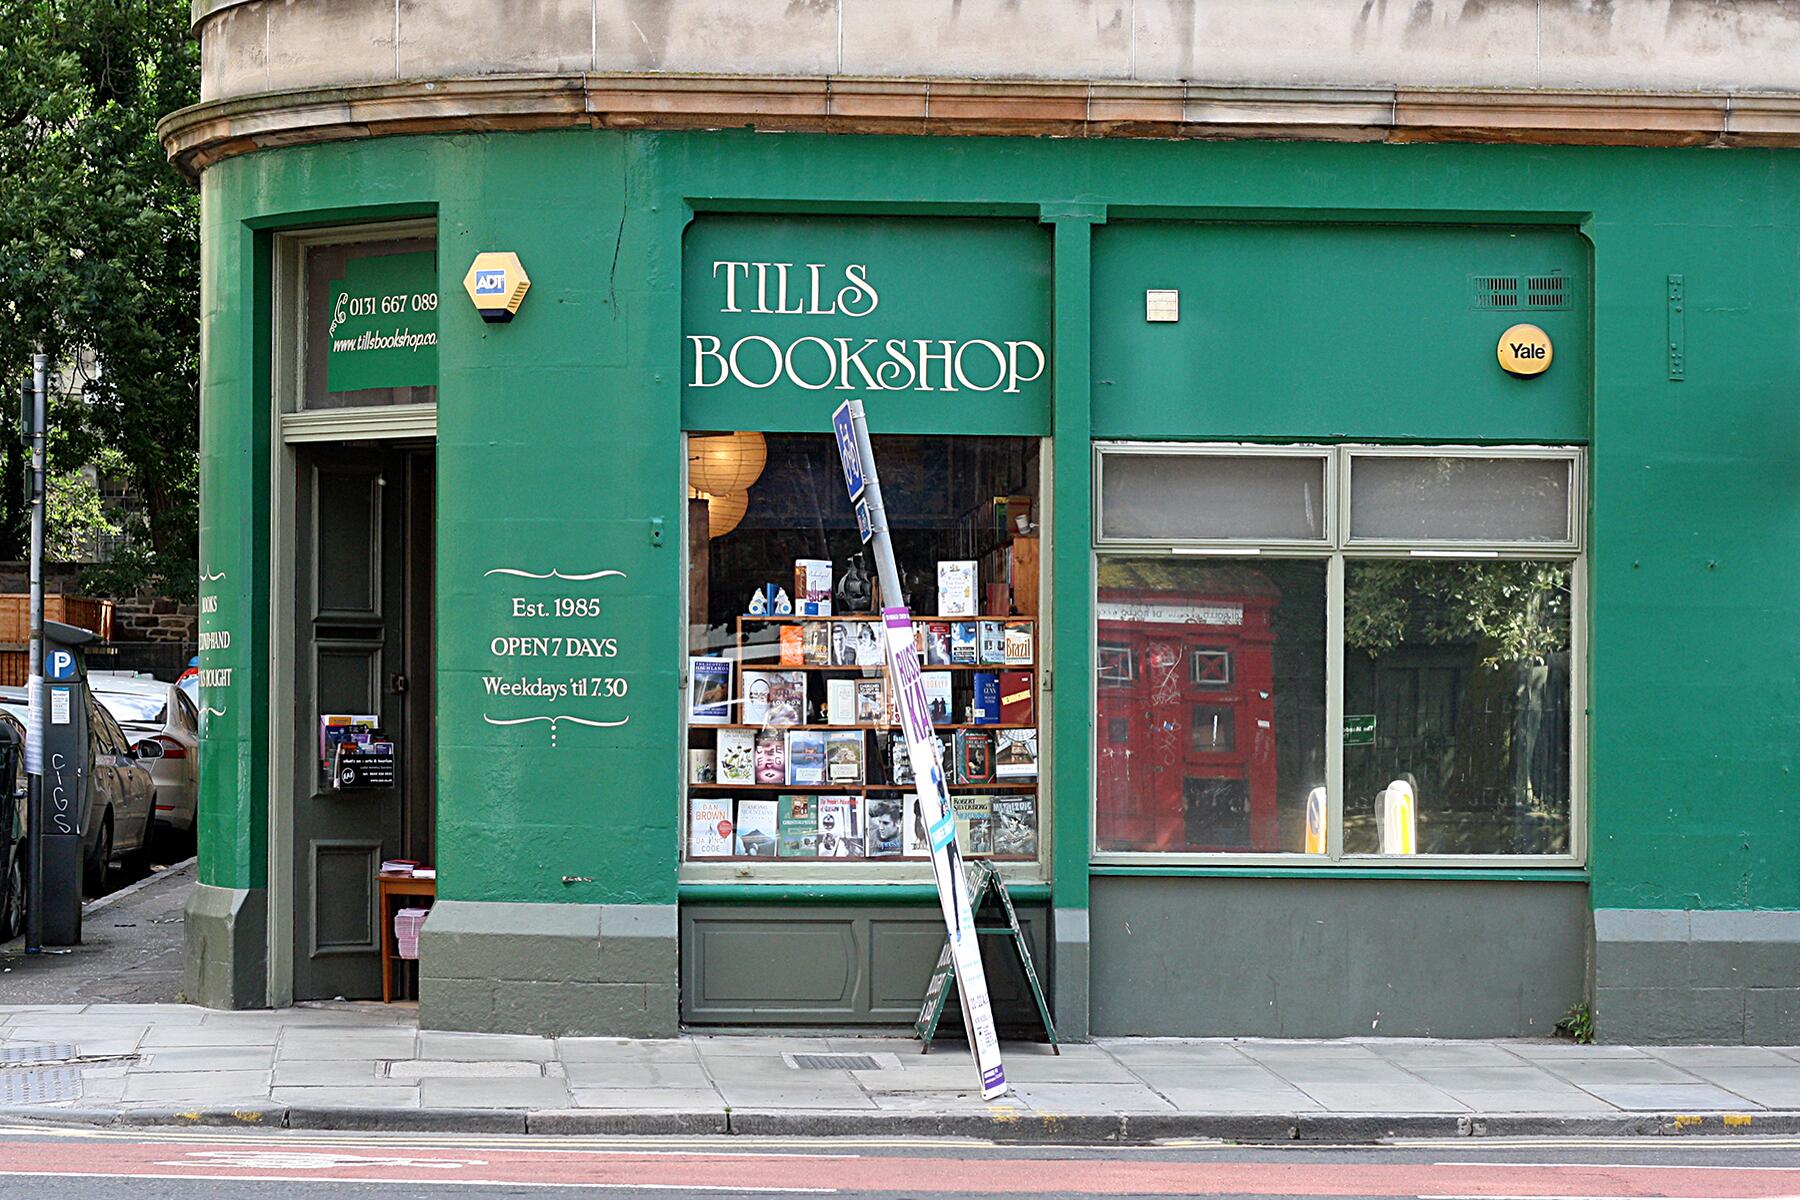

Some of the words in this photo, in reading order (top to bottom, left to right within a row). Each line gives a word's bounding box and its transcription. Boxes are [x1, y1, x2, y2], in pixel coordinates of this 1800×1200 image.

[477, 274, 504, 290] ADT
[713, 261, 879, 317] TILLS
[349, 298, 377, 316] 0131
[381, 295, 408, 314] 667
[1509, 343, 1546, 359] Yale
[686, 335, 1046, 393] BOOKSHOP
[512, 597, 550, 617] Est.
[554, 598, 601, 617] 1985
[490, 637, 550, 656] OPEN
[551, 637, 562, 657] 7
[566, 637, 618, 657] DAYS
[1006, 638, 1030, 658] Brazil
[54, 651, 71, 678] P
[482, 676, 567, 702] Weekdays
[591, 678, 628, 697] 7.30
[695, 811, 727, 821] BROWN
